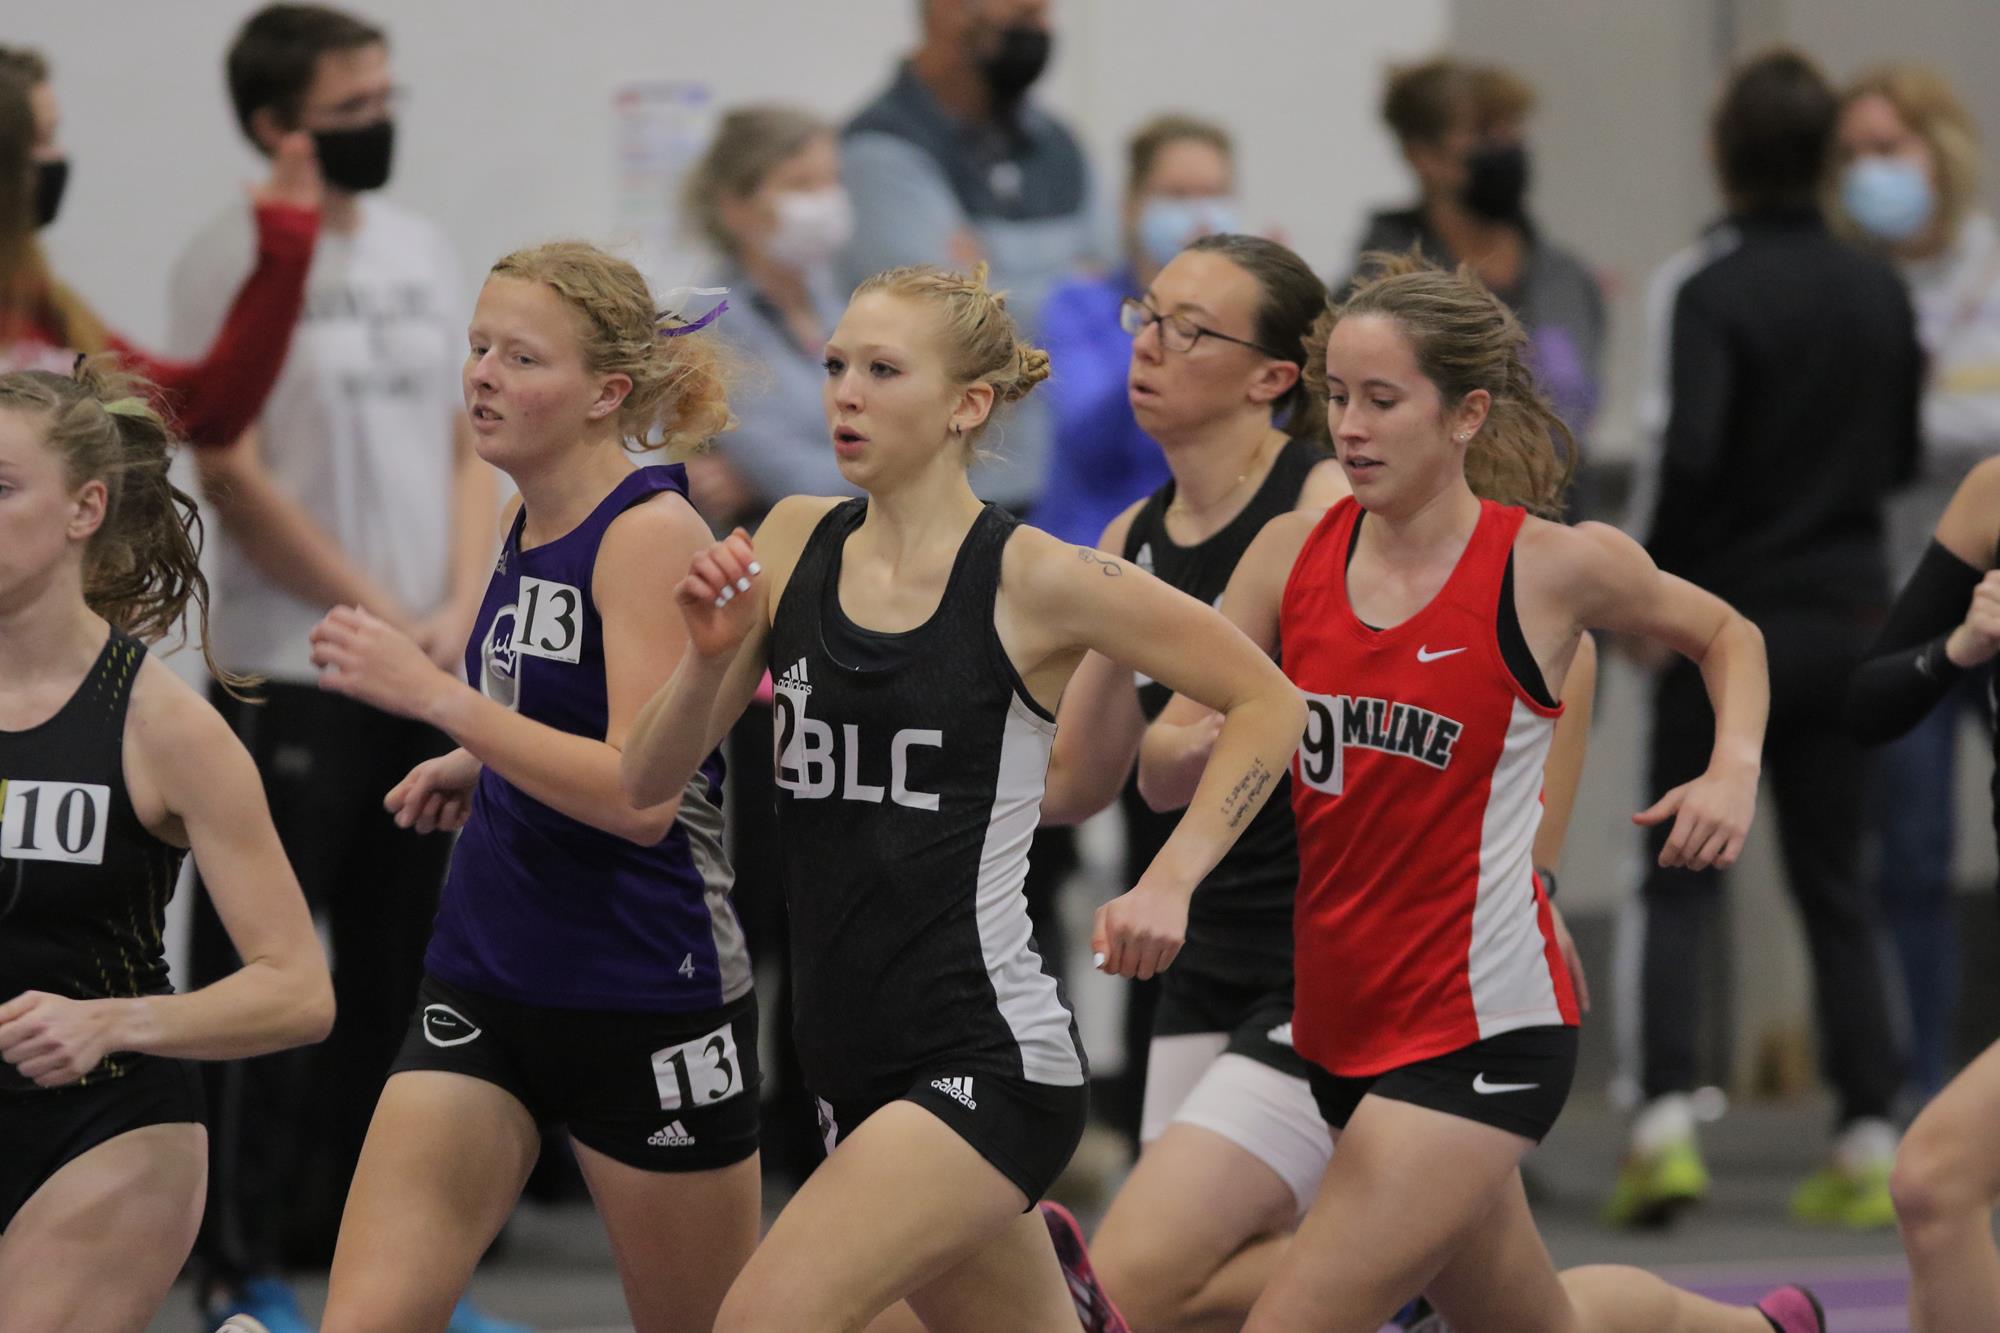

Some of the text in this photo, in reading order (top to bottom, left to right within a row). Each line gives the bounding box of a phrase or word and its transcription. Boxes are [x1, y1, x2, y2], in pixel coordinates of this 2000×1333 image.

[517, 583, 576, 652] 13
[793, 717, 943, 812] BLC
[1302, 699, 1335, 784] 9
[1341, 694, 1464, 770] MLINE
[10, 786, 96, 854] 10
[678, 952, 695, 979] 4
[662, 1035, 733, 1109] 13
[930, 1079, 977, 1111] adidas
